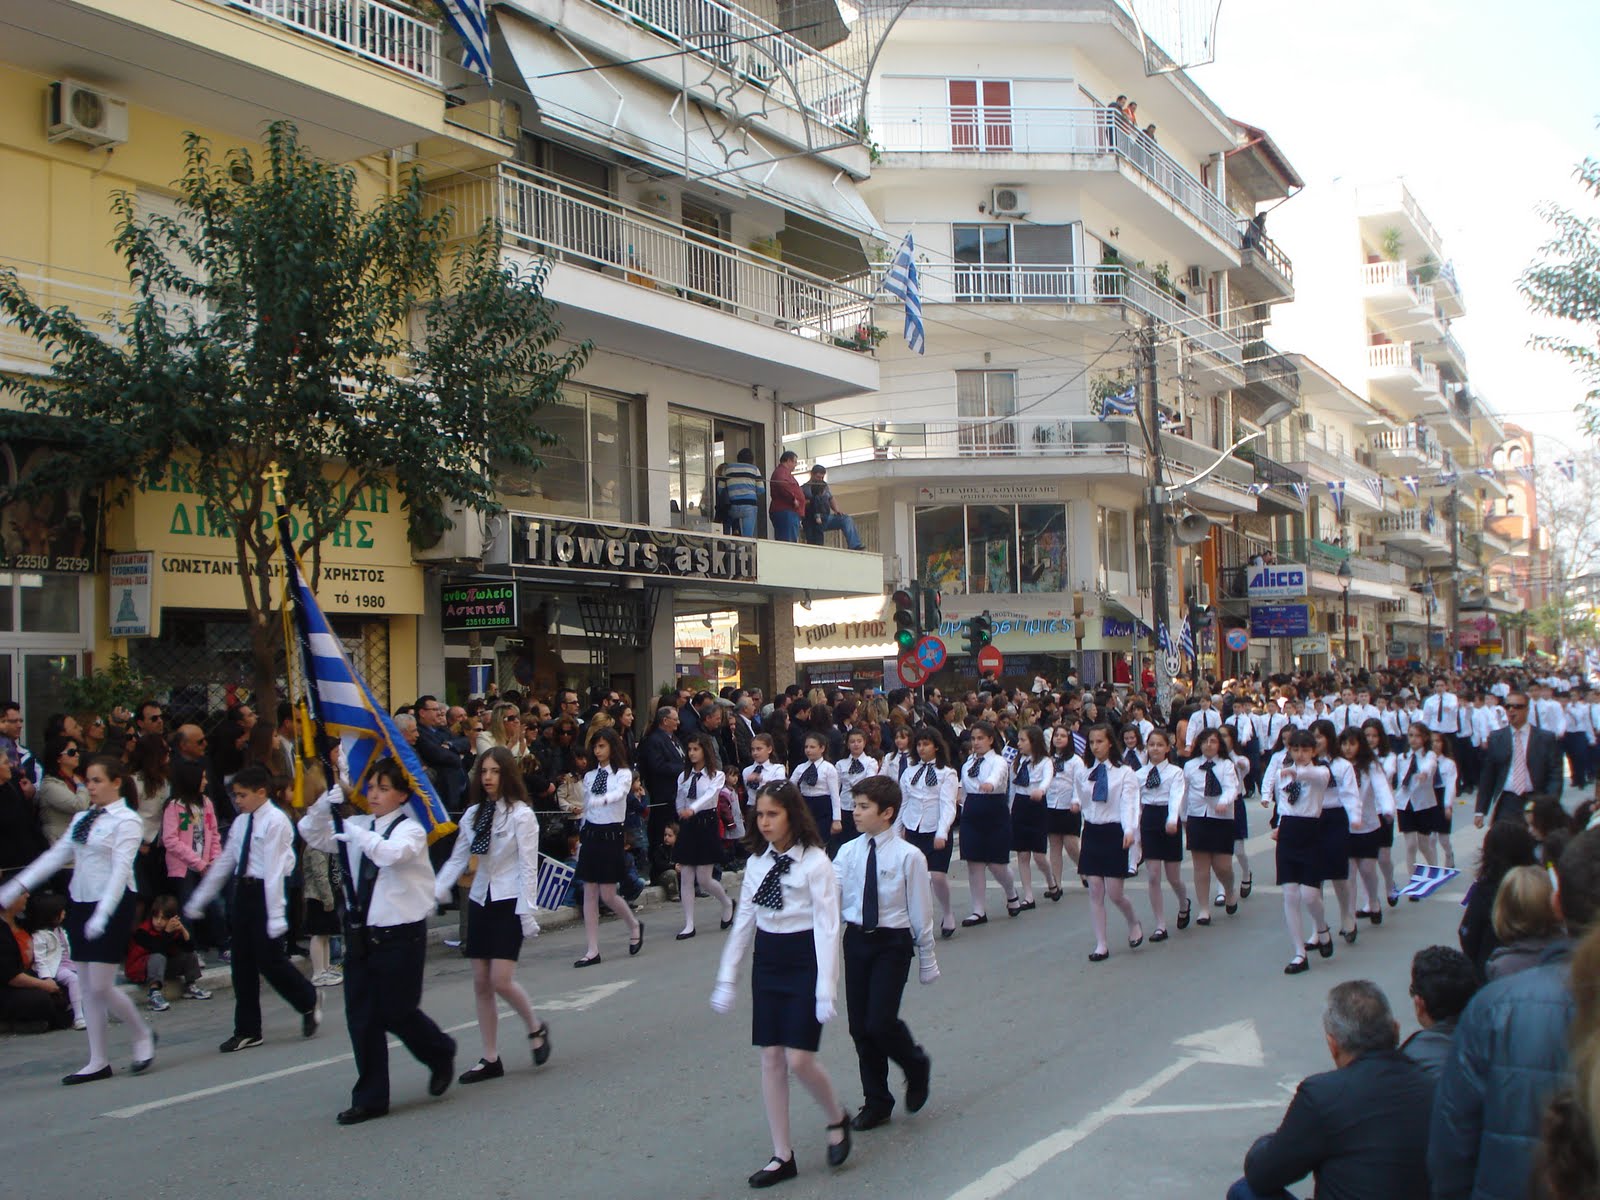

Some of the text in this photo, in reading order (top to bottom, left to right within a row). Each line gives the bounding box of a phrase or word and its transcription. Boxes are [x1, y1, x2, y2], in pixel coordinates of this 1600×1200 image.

[169, 502, 375, 549] ΔΙΑΡΟΦΗΣ
[526, 521, 659, 569] flowers
[16, 554, 90, 571] 23510 25799
[324, 567, 385, 583] ΧΡΗΣΤΟΣ
[355, 594, 386, 609] 1980
[445, 601, 506, 616] Ασκητή
[465, 618, 486, 626] 23510
[844, 621, 887, 640] ΓΥΡΟΣ
